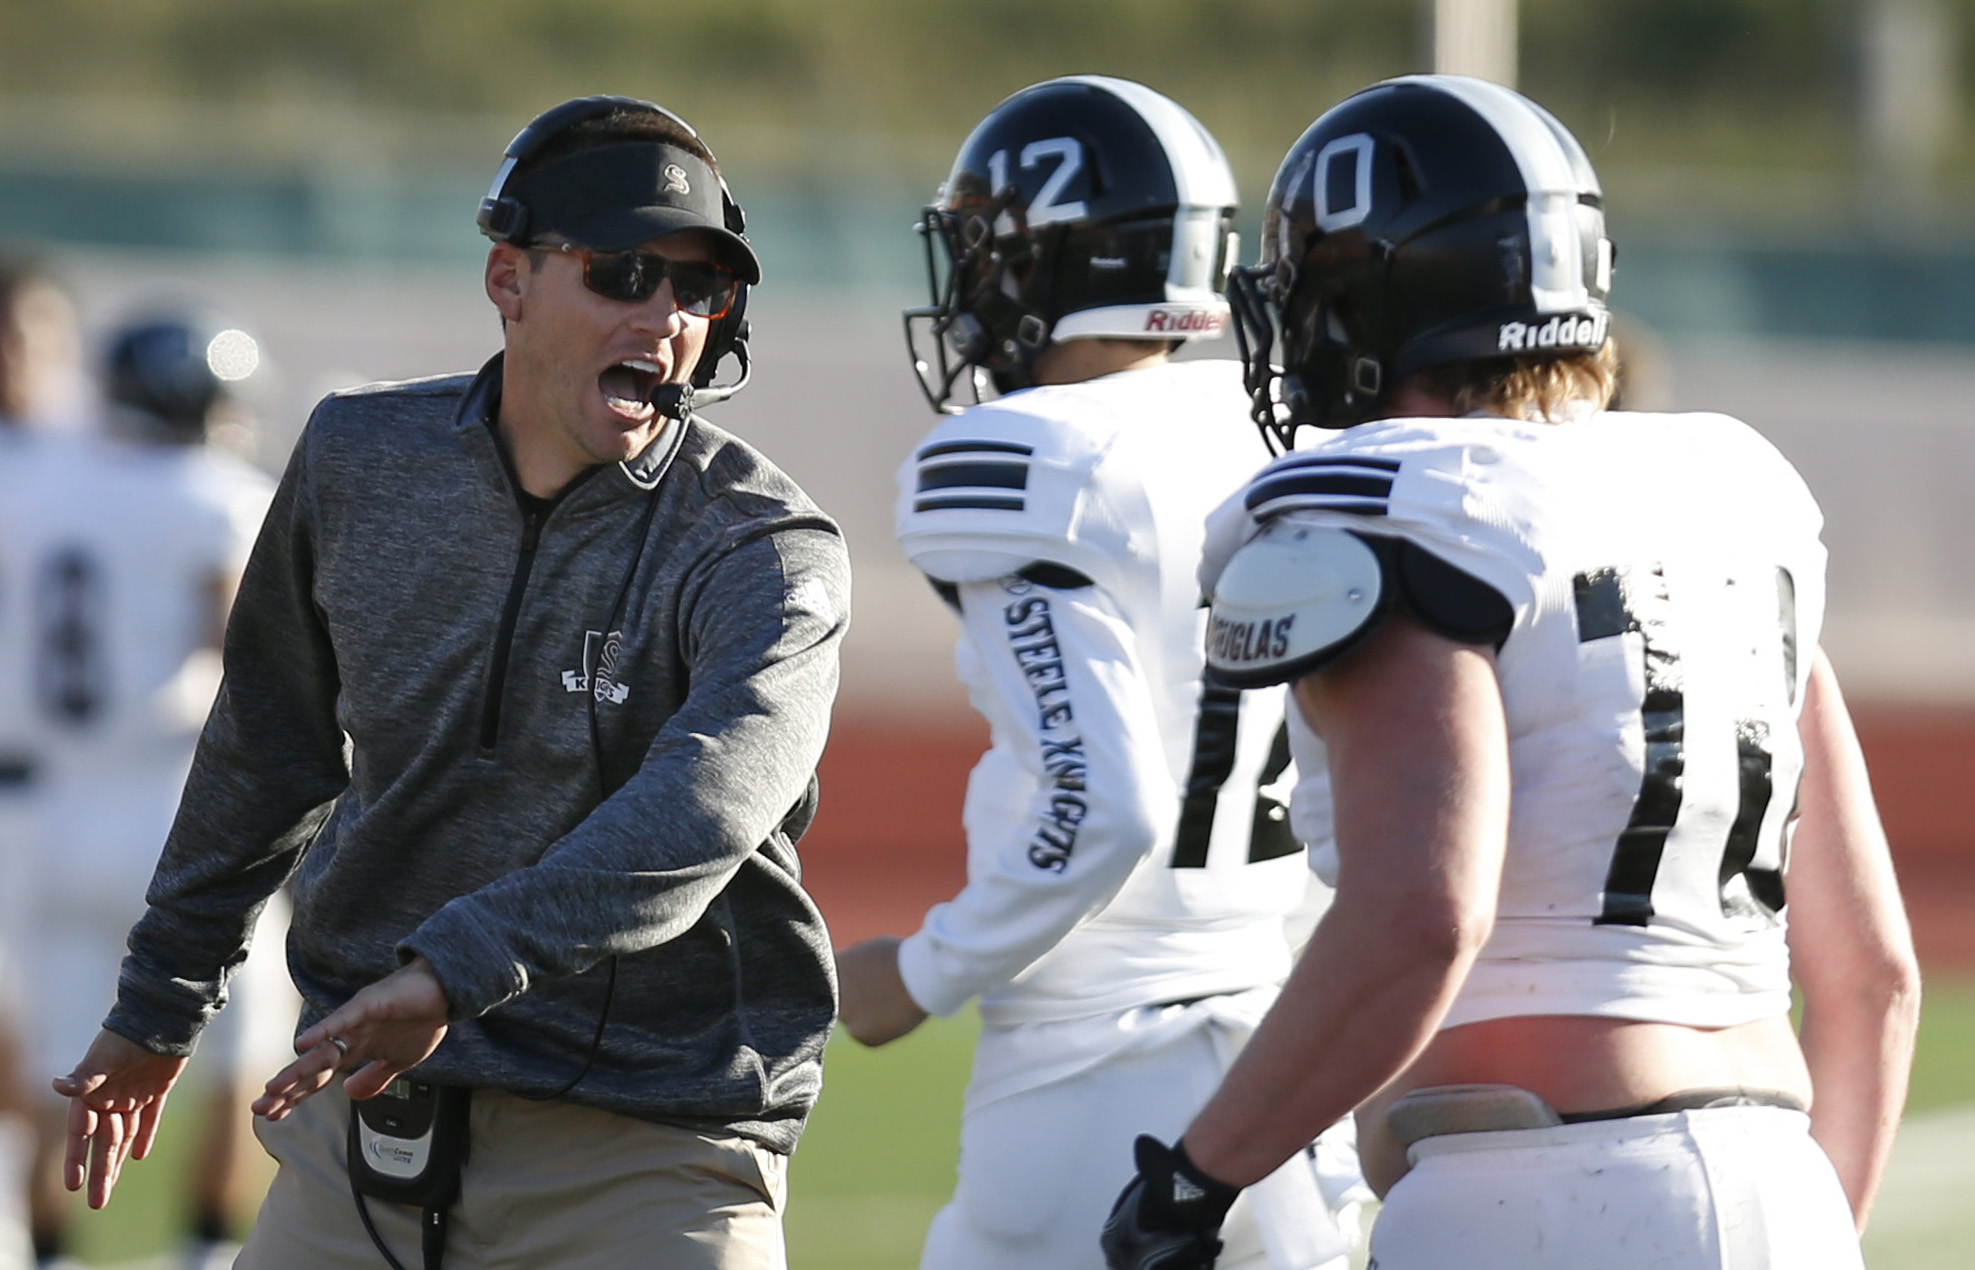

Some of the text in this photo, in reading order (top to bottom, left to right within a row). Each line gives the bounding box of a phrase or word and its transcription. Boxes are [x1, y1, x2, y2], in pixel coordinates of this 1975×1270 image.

[988, 136, 1089, 237] 12
[1498, 315, 1608, 350] Riddell
[1003, 596, 1073, 730] STEELE
